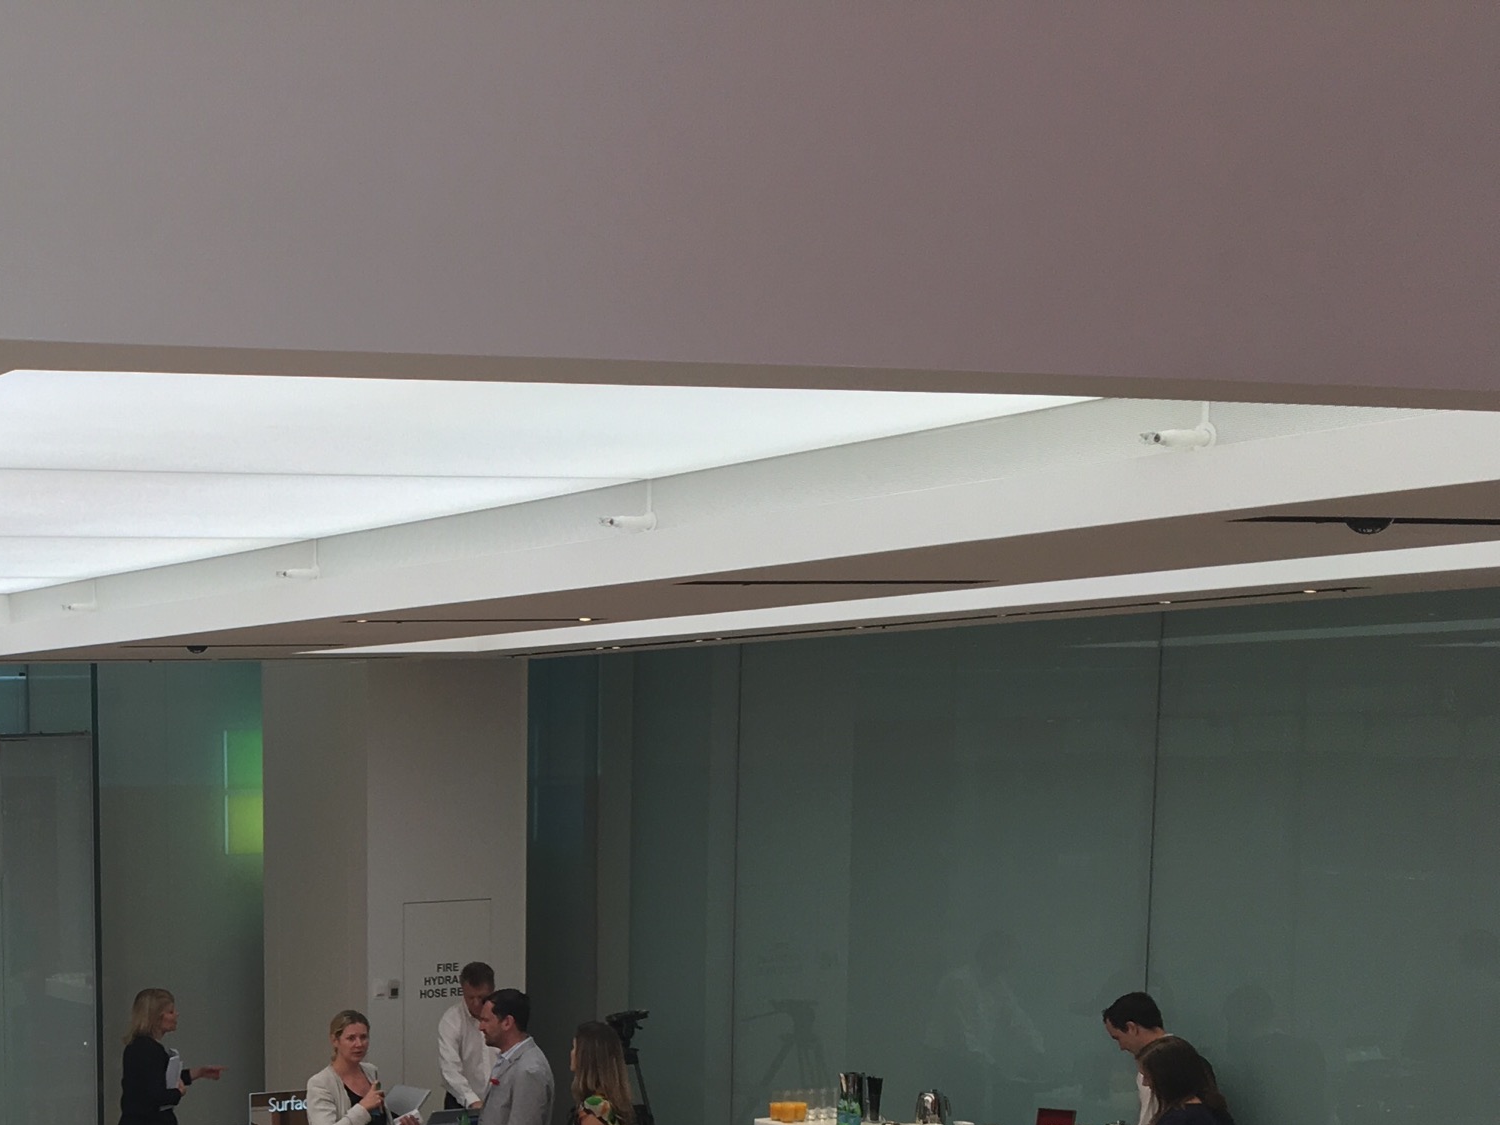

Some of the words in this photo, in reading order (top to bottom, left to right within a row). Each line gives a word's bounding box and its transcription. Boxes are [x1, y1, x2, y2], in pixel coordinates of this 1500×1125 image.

[436, 963, 459, 973] FIRE
[424, 975, 462, 986] HYDRA
[420, 988, 448, 999] HOSE
[450, 987, 464, 997] RE
[268, 1095, 308, 1113] Surfac
